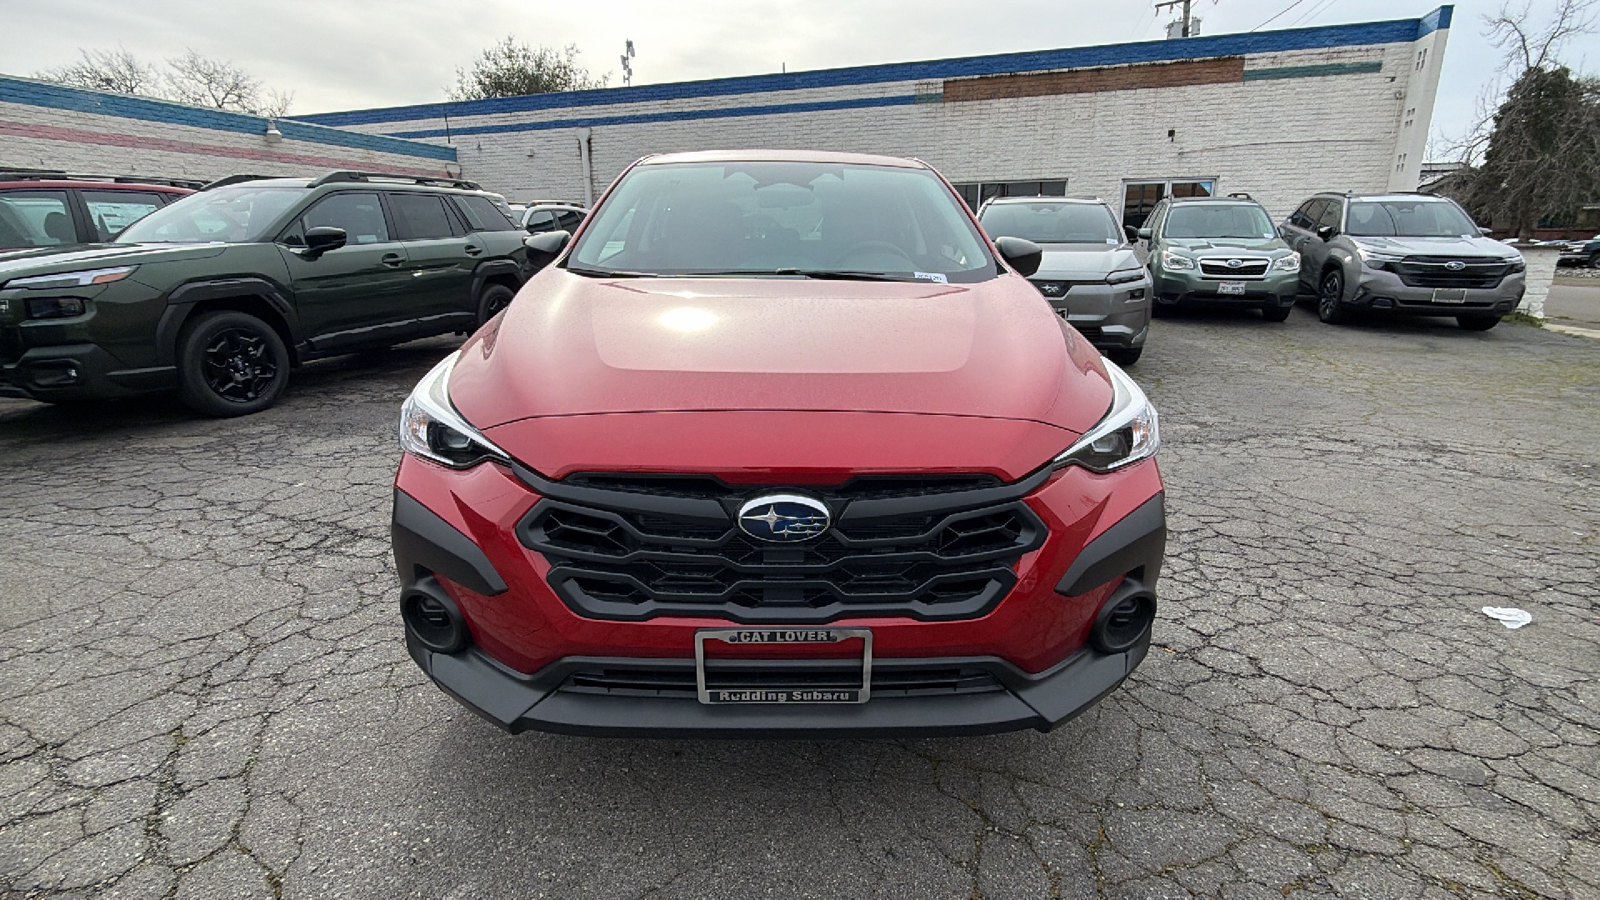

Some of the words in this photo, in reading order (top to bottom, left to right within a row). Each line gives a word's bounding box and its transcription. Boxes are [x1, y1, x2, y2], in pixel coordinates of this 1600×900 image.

[740, 631, 770, 642] CAT
[776, 631, 828, 642] LOVER
[720, 691, 787, 702] Redding
[792, 691, 849, 700] Subaru
